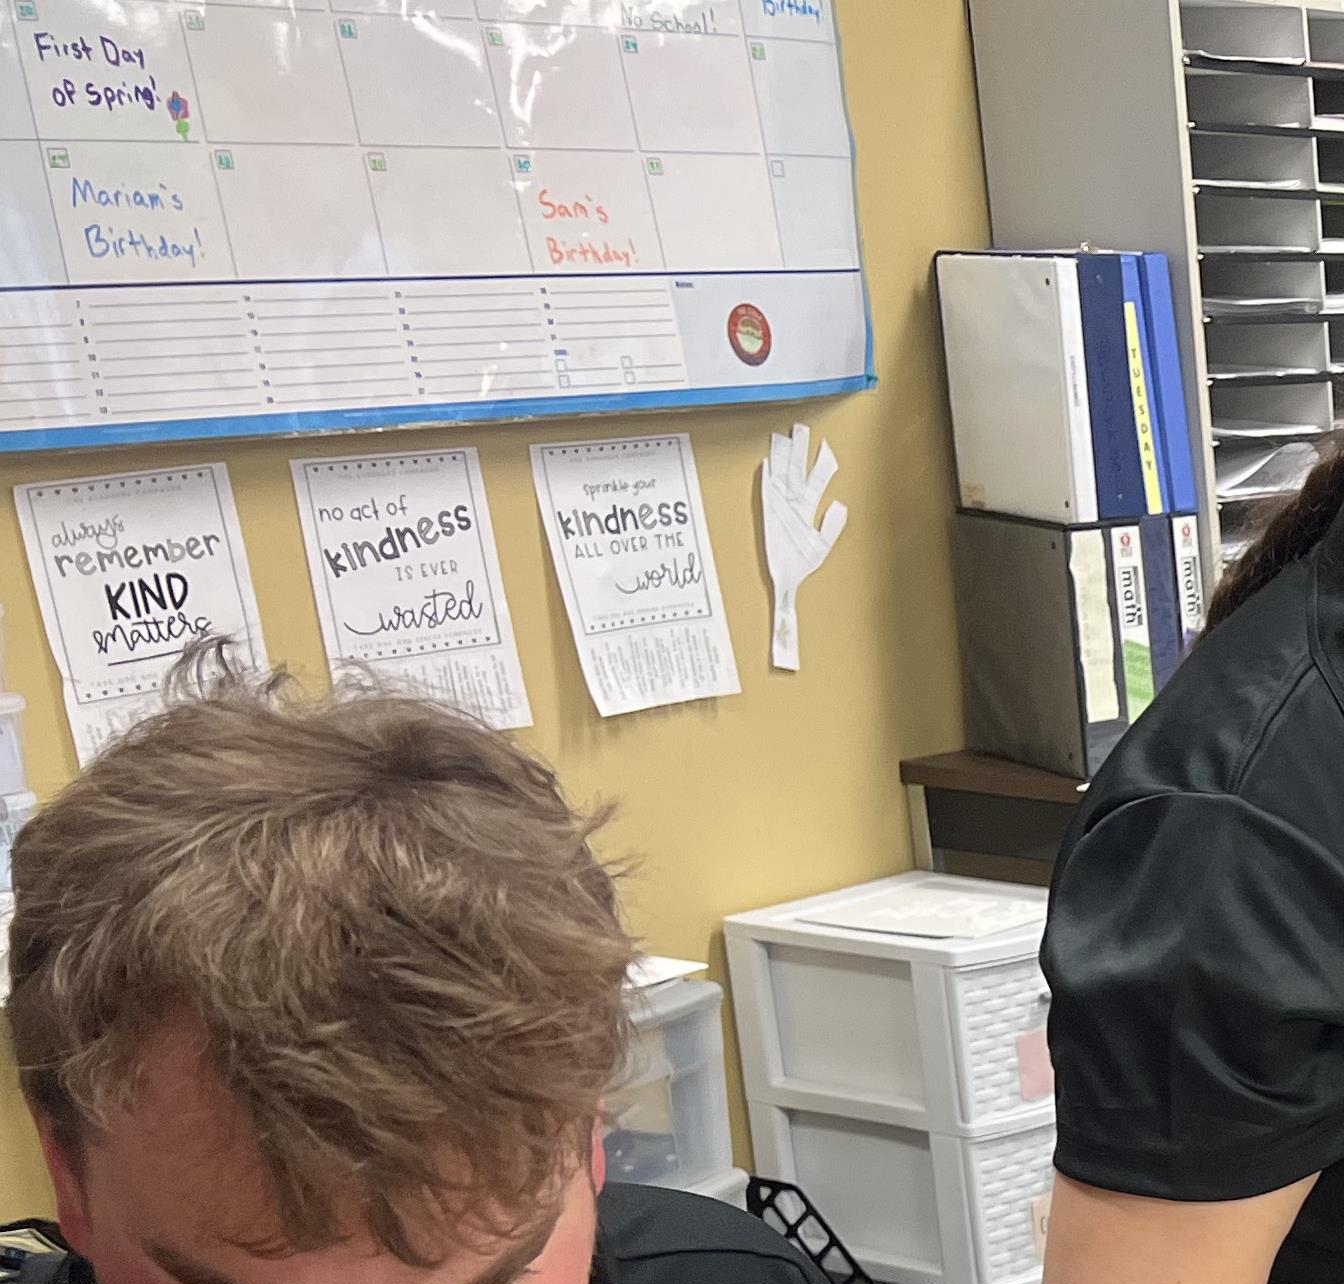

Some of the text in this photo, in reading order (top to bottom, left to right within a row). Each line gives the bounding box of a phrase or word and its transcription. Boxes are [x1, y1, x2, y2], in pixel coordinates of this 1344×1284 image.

[620, 2, 718, 34] No School!
[33, 31, 146, 70] First Day
[51, 78, 76, 107] of
[72, 176, 184, 211] Mariam's
[538, 188, 609, 225] Sam's
[84, 223, 206, 269] Birthday!
[546, 236, 640, 268] Birthday!
[1130, 347, 1153, 471] TUESDAY
[632, 478, 657, 496] your
[318, 494, 409, 523] no act of
[557, 500, 689, 540] kindness
[51, 514, 125, 550] always
[323, 504, 472, 578] kindness
[574, 531, 685, 559] ALL OVER THE
[53, 533, 220, 578] remember
[396, 559, 459, 582] IS EVER
[615, 551, 704, 595] world
[104, 572, 189, 621] KIND
[343, 579, 484, 637] wasted
